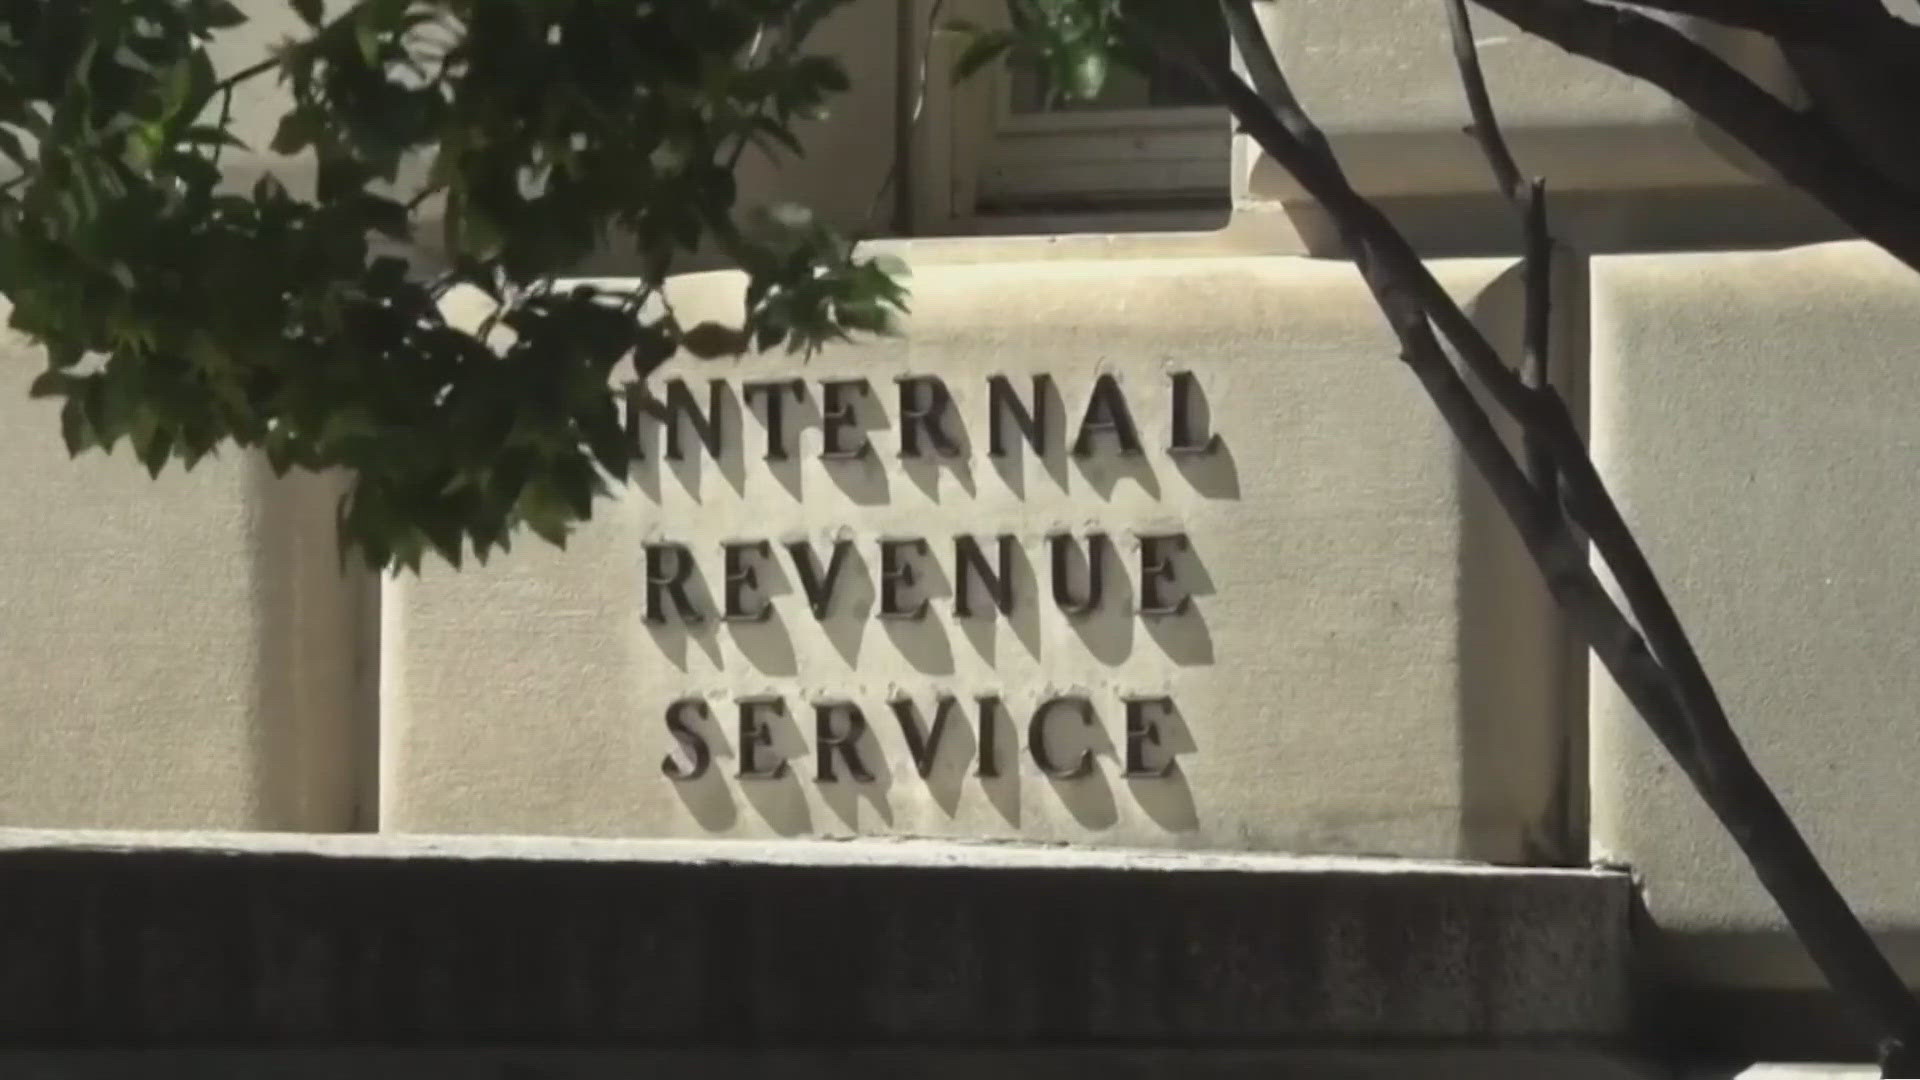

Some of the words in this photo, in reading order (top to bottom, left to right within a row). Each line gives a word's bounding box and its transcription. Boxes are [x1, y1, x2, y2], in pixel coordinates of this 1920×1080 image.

[622, 371, 1221, 460] INTERNAL
[642, 533, 1188, 623] REVENUE
[661, 695, 1176, 782] SERVICE
